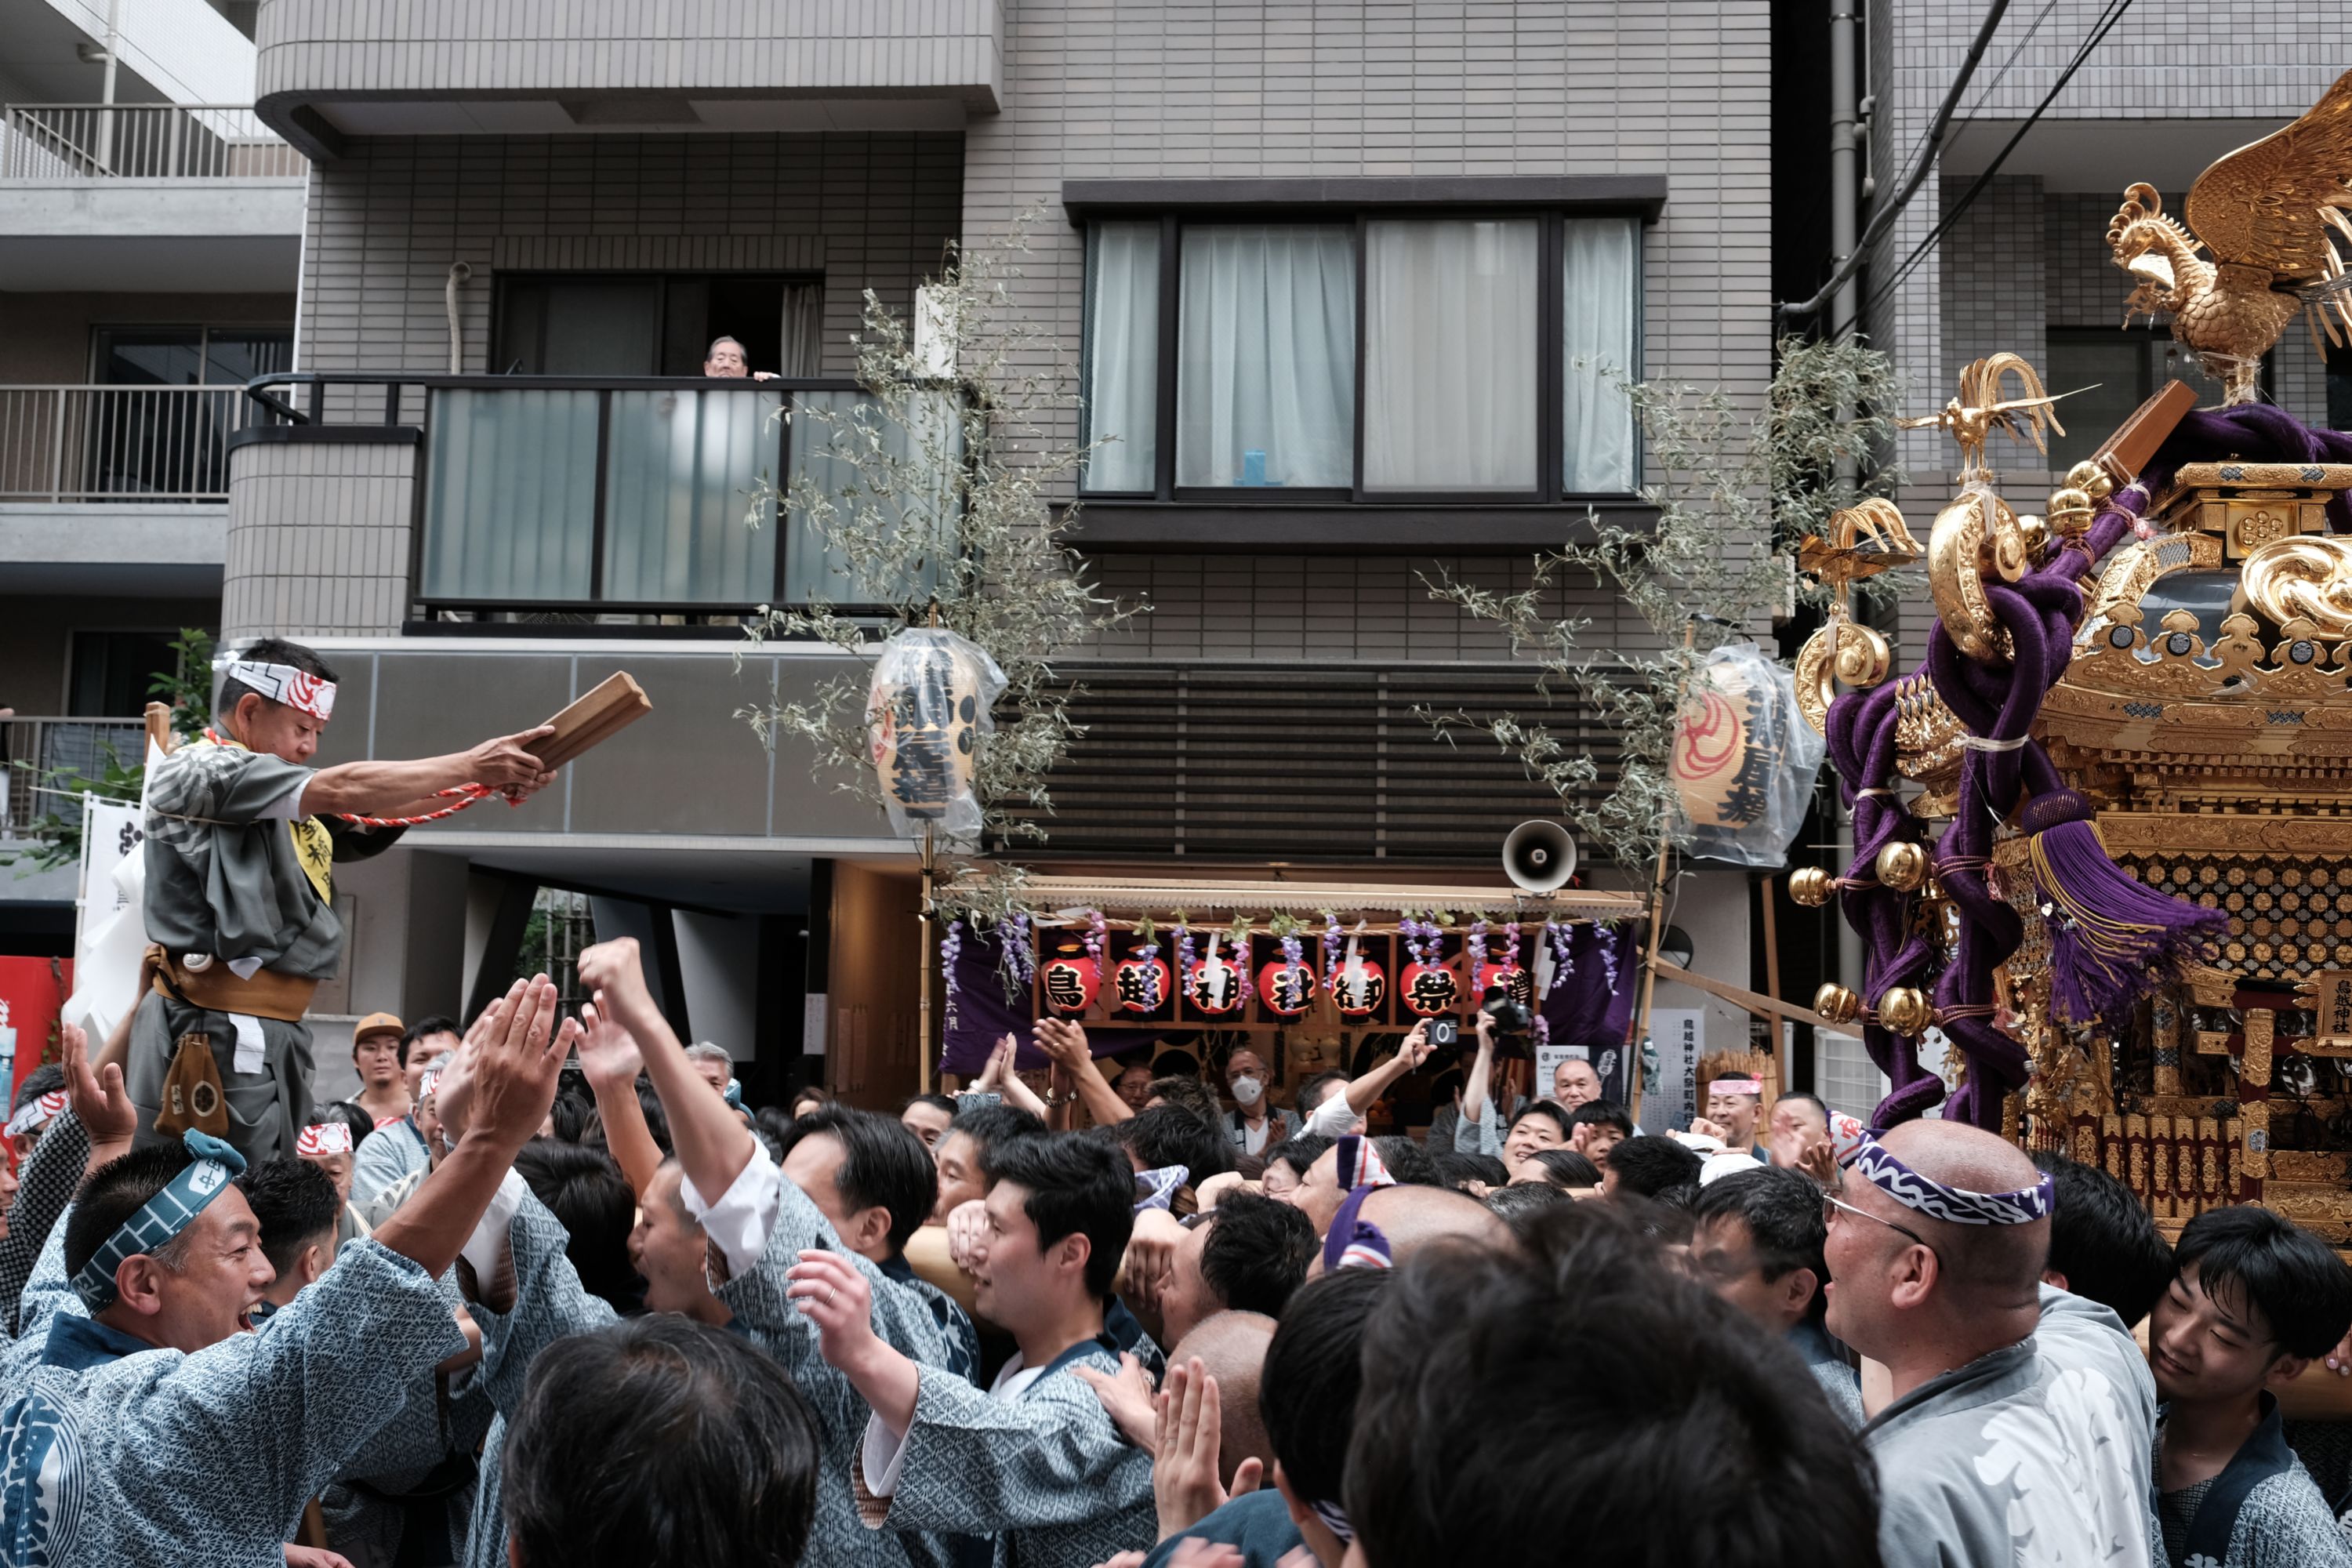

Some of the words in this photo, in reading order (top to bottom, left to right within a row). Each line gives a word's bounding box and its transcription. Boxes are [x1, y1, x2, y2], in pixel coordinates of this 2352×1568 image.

[1046, 963, 1087, 1009] 鳥
[1405, 969, 1457, 1012] 祭
[2332, 979, 2352, 1034] 鳥越神社
